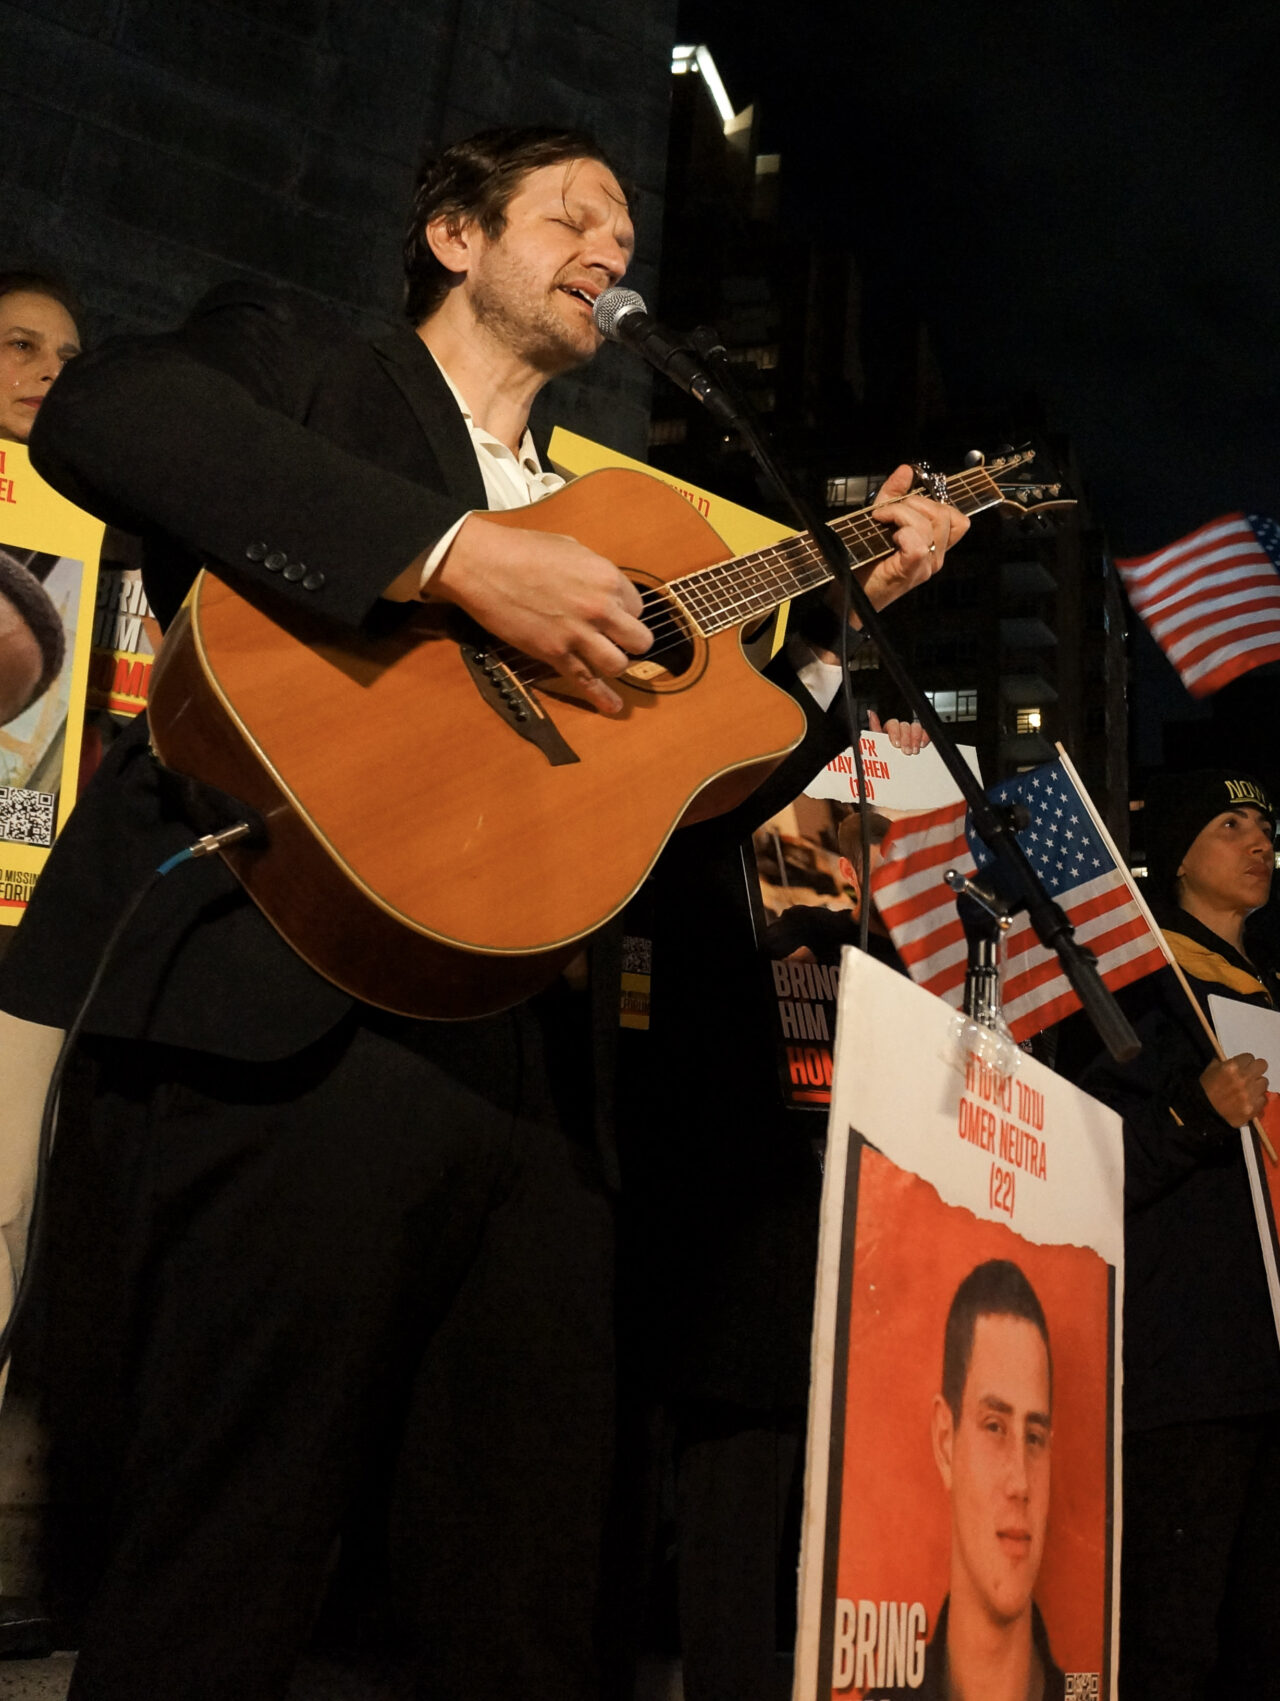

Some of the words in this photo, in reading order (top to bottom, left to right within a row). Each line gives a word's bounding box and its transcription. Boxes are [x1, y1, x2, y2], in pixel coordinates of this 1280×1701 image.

[778, 1001, 830, 1041] HIM
[958, 1097, 995, 1155] OMER
[999, 1119, 1046, 1181] NEUTRA
[989, 1161, 1015, 1219] (22)
[831, 1598, 927, 1689] BRING
